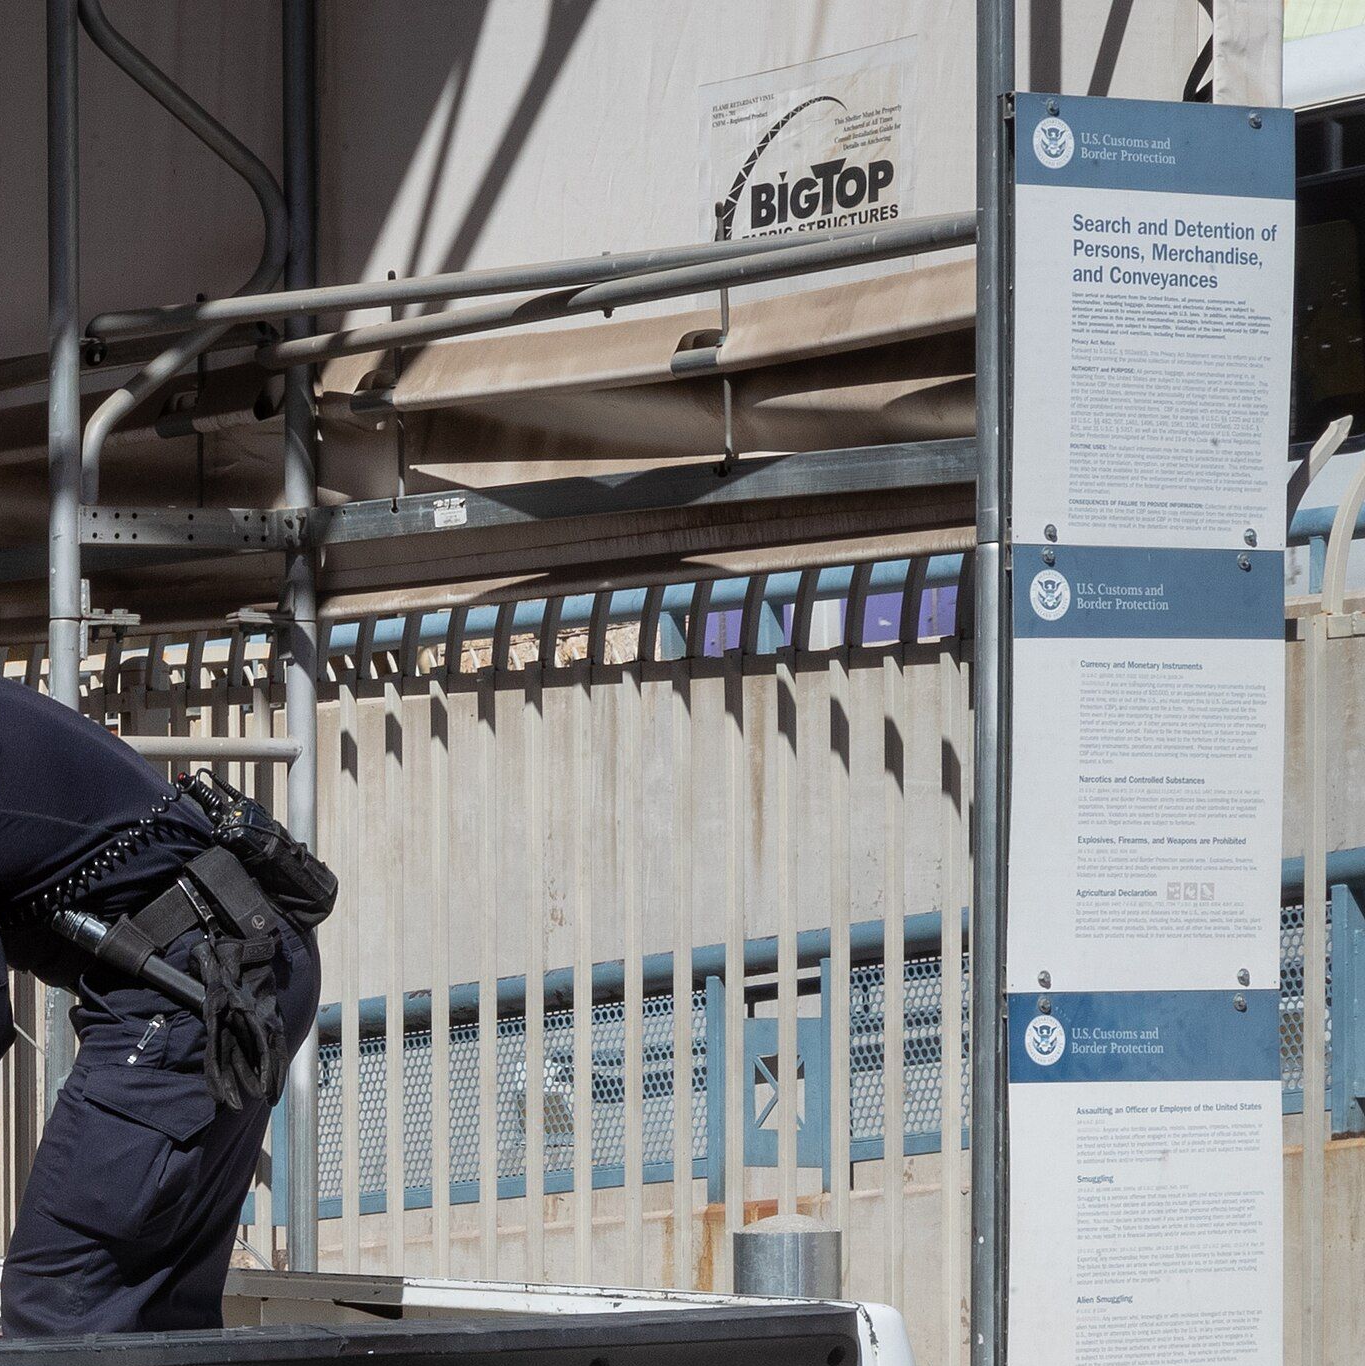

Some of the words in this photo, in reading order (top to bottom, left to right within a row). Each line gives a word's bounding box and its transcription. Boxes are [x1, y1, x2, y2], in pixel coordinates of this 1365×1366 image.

[1081, 132, 1101, 145] U.S.
[1102, 134, 1149, 148] Customs
[1151, 137, 1171, 149] and
[1081, 147, 1117, 160] Border
[1121, 150, 1176, 164] Protection
[798, 204, 898, 232] STRUCTURES
[1073, 214, 1131, 233] Search
[1138, 219, 1168, 235] and
[1174, 219, 1255, 240] Detention
[1261, 224, 1277, 241] of
[1073, 239, 1144, 261] Persons,
[1152, 243, 1263, 268] Merchandise,
[1073, 266, 1103, 282] and
[1110, 267, 1218, 290] Conveyances
[1076, 583, 1096, 594] U.S.
[1097, 583, 1143, 595] Customs
[1144, 584, 1164, 596] and
[1077, 597, 1112, 609] Border
[1115, 598, 1169, 610] Protection
[1080, 660, 1111, 670] Currency
[1127, 661, 1160, 671] Monetary
[1161, 662, 1203, 670] Instruments
[1079, 775, 1112, 783] Narcotics
[1128, 775, 1164, 784] Controlled
[1165, 776, 1205, 784] Substances
[1077, 835, 1116, 844] Explosives,
[1118, 836, 1150, 844] Firearms,
[1152, 836, 1165, 844] and
[1166, 837, 1198, 845] Weapons
[1212, 836, 1246, 845] Prohibited
[1076, 889, 1117, 898] Agricultural
[1072, 1027, 1091, 1039] U.S.
[1093, 1027, 1138, 1039] Customs
[1139, 1026, 1159, 1039] and
[1072, 1042, 1107, 1054] Border
[1110, 1042, 1164, 1054] Protection
[1076, 1107, 1113, 1115] Assaulting
[1125, 1105, 1149, 1113] Officer
[1159, 1104, 1192, 1113] Employee
[1194, 1103, 1201, 1112] of
[1215, 1103, 1238, 1111] United
[1239, 1102, 1262, 1110] States
[1077, 1174, 1114, 1184] Smuggling
[1076, 1296, 1094, 1304] Alien
[1096, 1294, 1133, 1304] Smuggling
